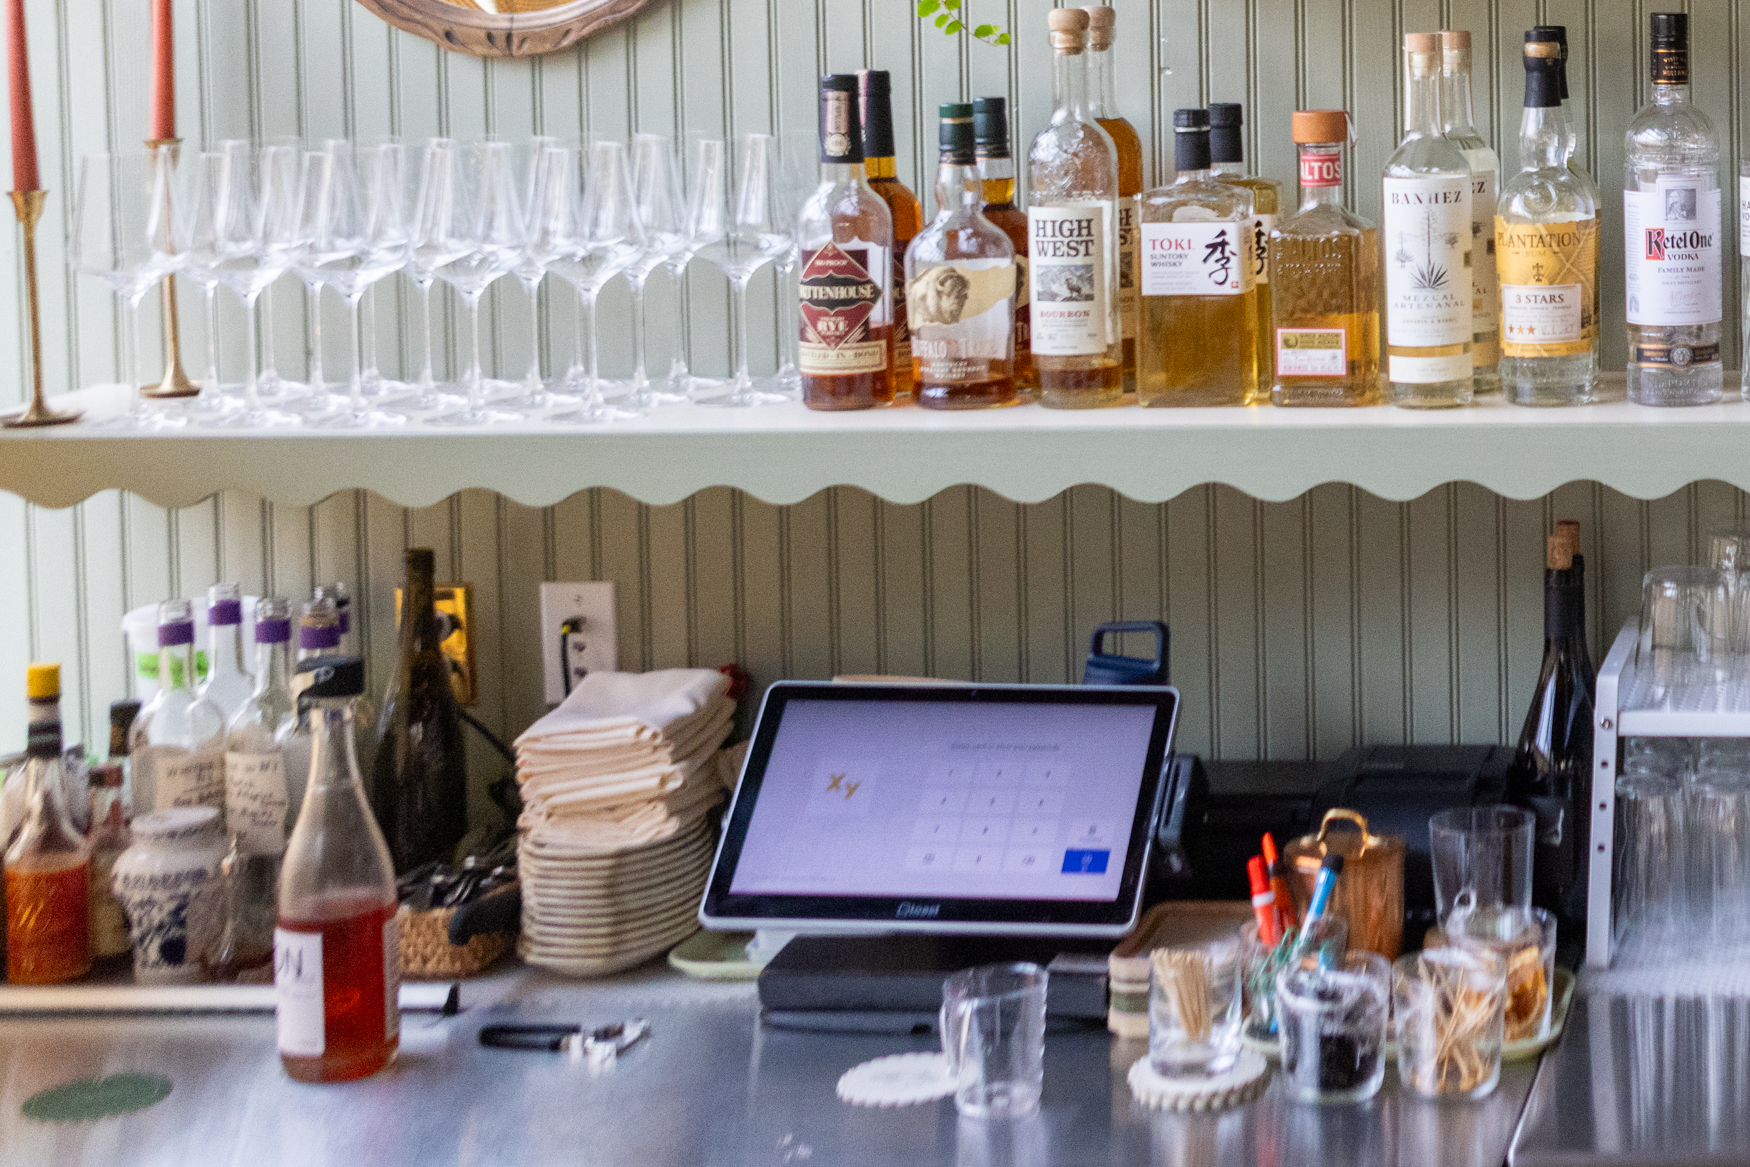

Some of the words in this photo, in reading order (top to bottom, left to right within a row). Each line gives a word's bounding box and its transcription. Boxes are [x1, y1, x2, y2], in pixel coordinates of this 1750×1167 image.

[1301, 161, 1341, 180] ALTOS
[1391, 191, 1462, 205] BANHEZ
[1035, 219, 1094, 238] HIGH
[1149, 238, 1192, 251] TOKI
[1497, 232, 1580, 249] PLANTATION
[1647, 229, 1688, 259] Ketel
[1689, 230, 1712, 250] One
[1036, 239, 1094, 257] WEST
[1202, 229, 1237, 286] 季
[1667, 253, 1699, 261] VODKA
[1393, 300, 1465, 309] ARTESANAL
[1403, 294, 1456, 302] MEZCAL
[1515, 294, 1522, 304] 3
[1525, 294, 1565, 304] STARS
[1040, 310, 1090, 318] BOURBON
